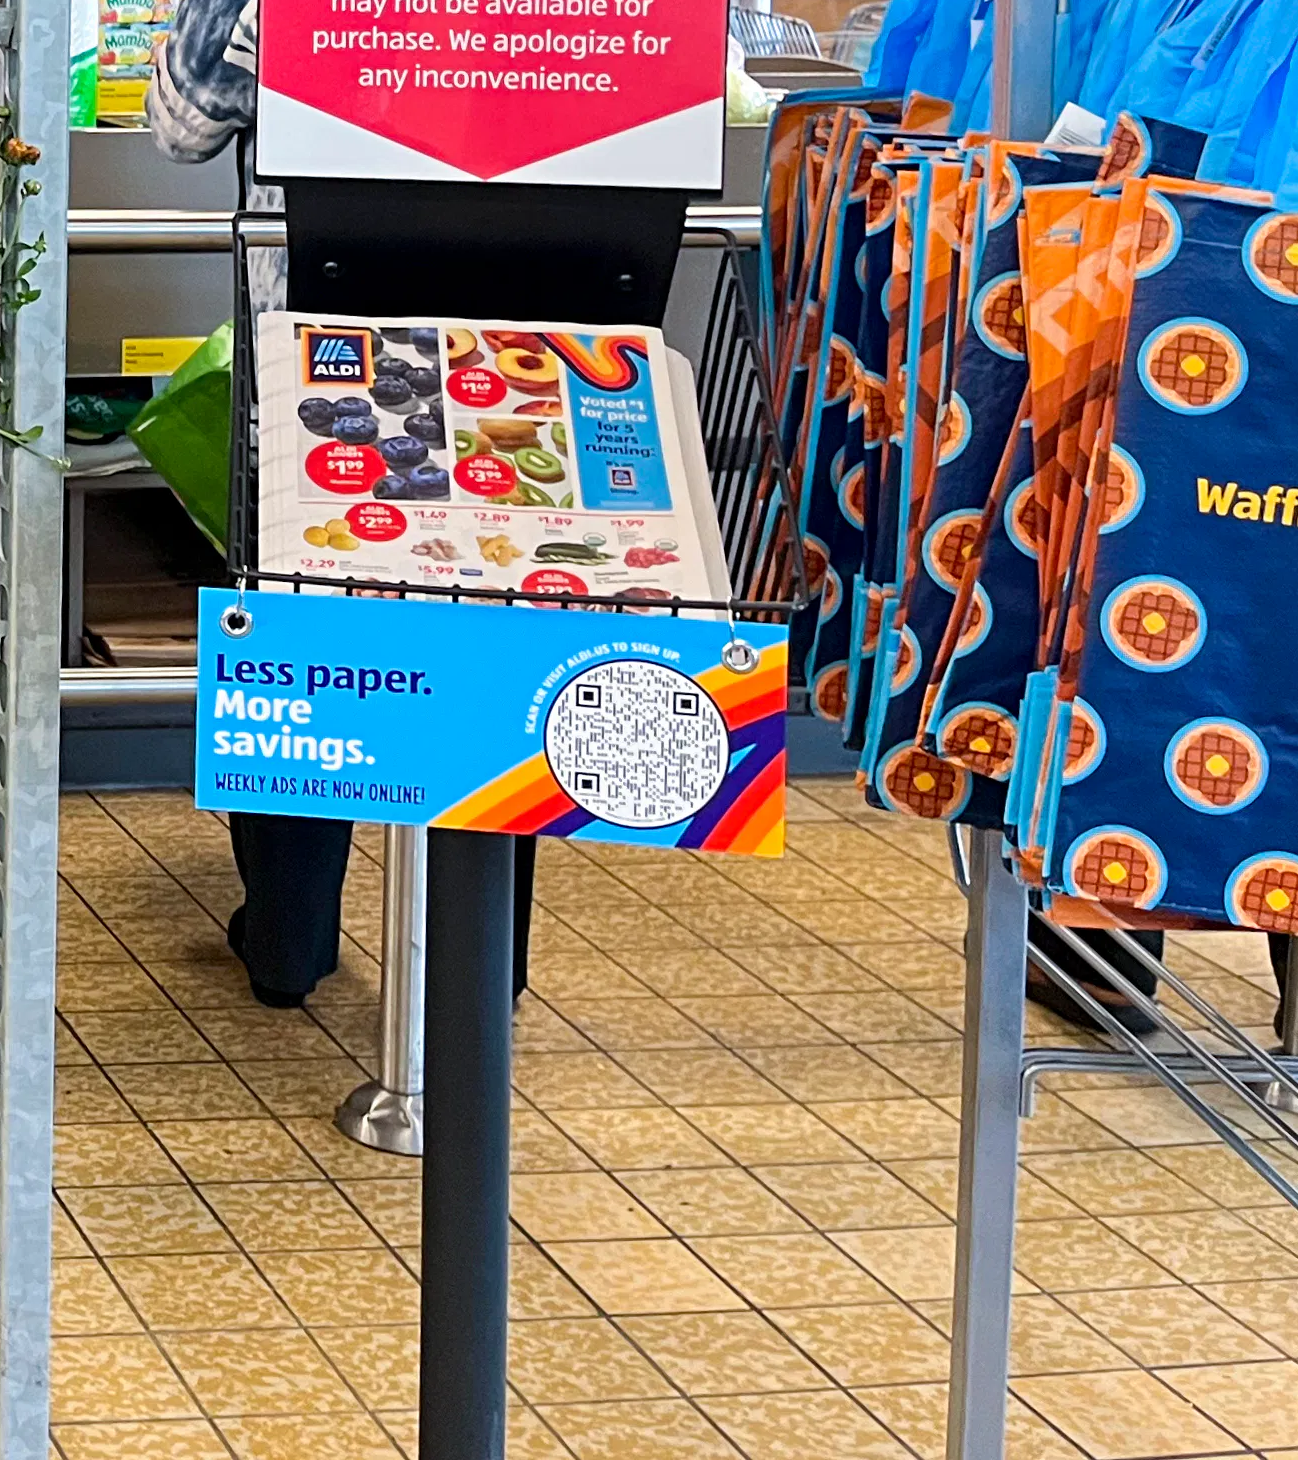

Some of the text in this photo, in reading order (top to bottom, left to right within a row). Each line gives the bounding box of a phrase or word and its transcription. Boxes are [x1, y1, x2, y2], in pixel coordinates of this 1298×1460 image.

[105, 30, 153, 51] Mamba
[312, 27, 672, 60] purchase. We apologize for
[358, 64, 619, 94] any inconvenience.
[313, 364, 361, 377] ALDI
[580, 396, 627, 409] Voted
[580, 406, 648, 422] for price
[595, 432, 639, 445] years
[597, 421, 634, 433] for 5
[1196, 476, 1298, 527] Waff
[215, 653, 433, 698] Less paper.
[525, 642, 681, 734] SCAN OR VISIT ALDI.US TO SIGN UP.
[214, 689, 312, 725] More
[213, 725, 376, 771] savings.
[215, 772, 426, 805] WEEKLY ADS ARE NOW ONLINE!
